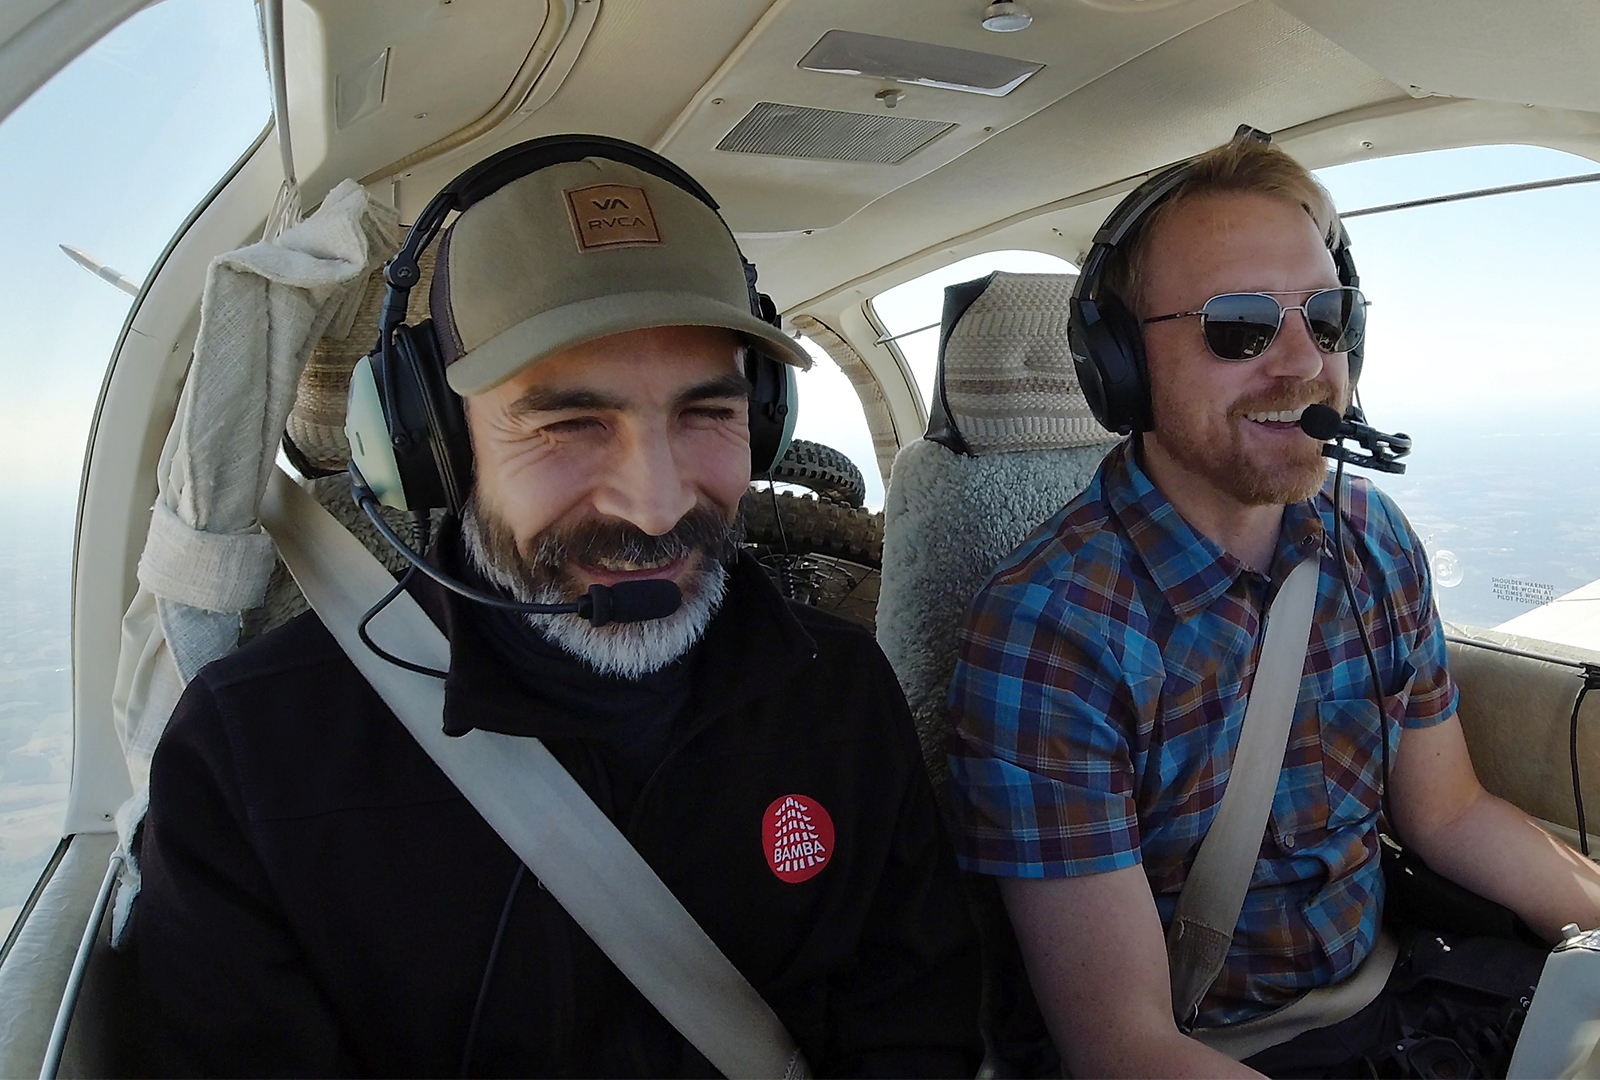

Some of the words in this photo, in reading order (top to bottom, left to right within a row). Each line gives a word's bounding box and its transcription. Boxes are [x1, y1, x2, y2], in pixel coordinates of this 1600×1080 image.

[588, 217, 646, 229] RVCA
[1491, 577, 1522, 586] SHOULDER
[1525, 581, 1554, 590] HARNESS
[1505, 589, 1522, 597] TIMES
[1515, 596, 1549, 606] POSITIONS
[774, 840, 826, 863] BAMBA
